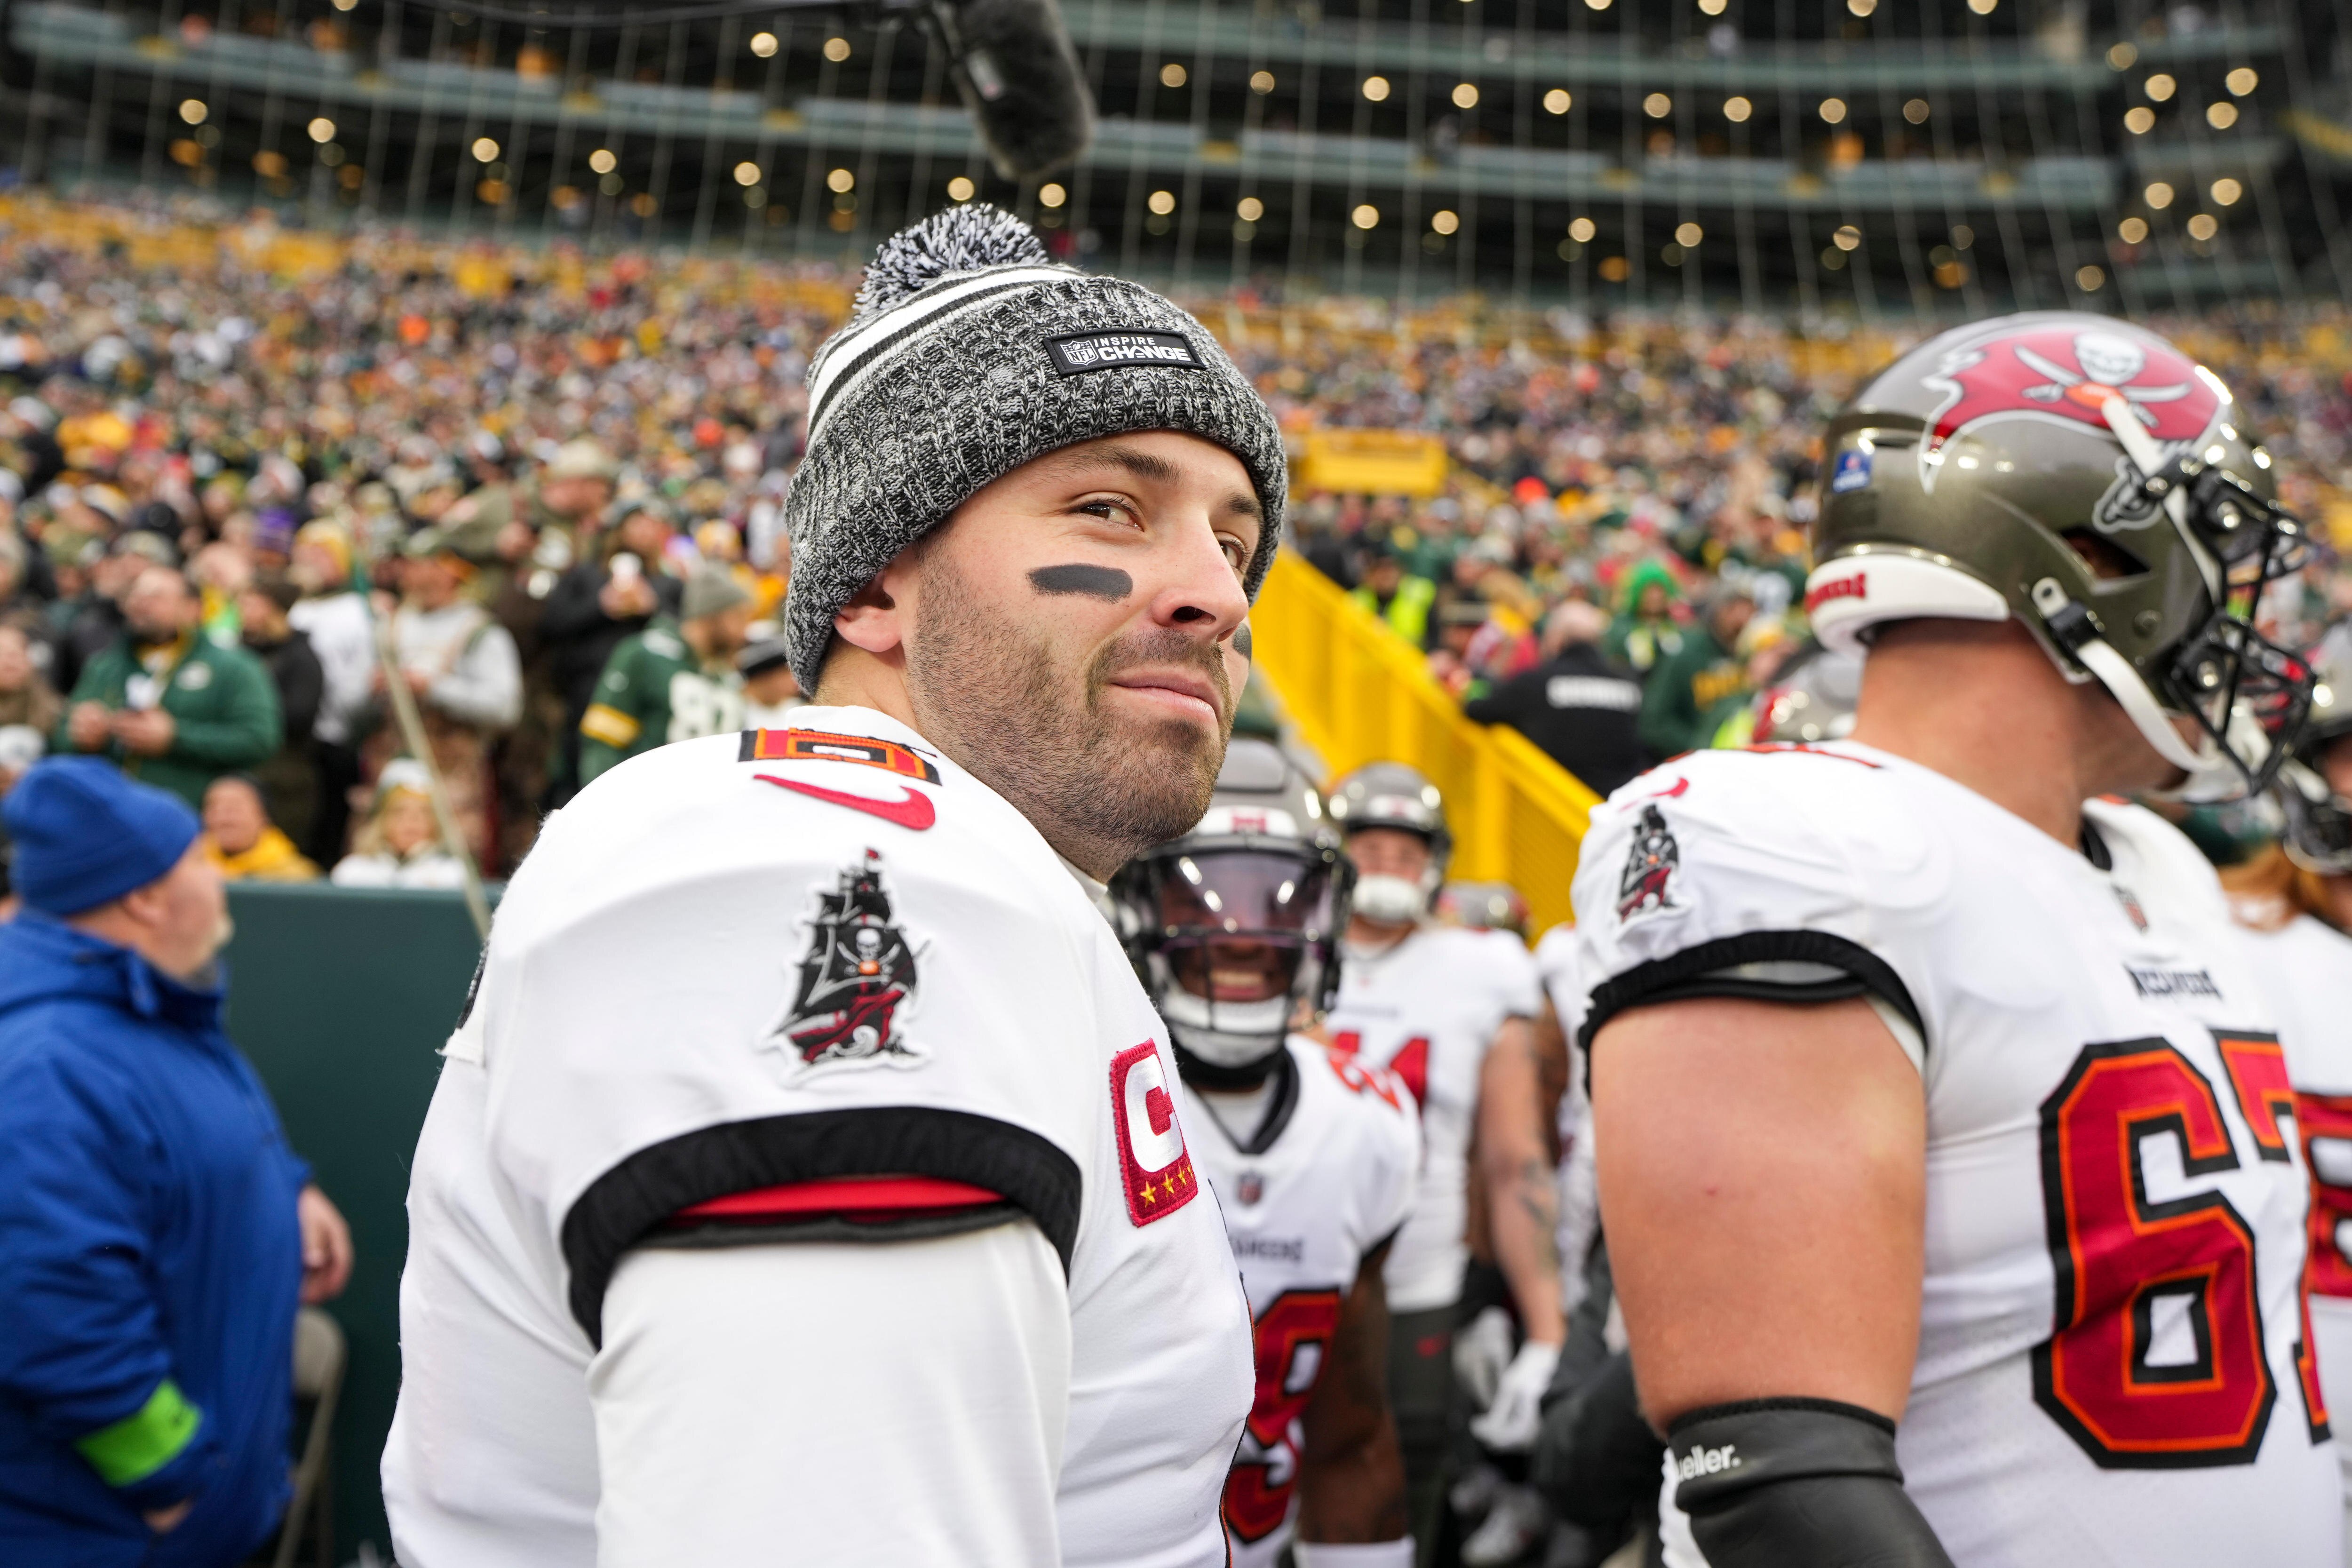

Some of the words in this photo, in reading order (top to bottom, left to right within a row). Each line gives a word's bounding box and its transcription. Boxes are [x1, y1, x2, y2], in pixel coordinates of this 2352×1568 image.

[1093, 337, 1155, 348] INSPIRE
[1068, 349, 1095, 362] NFL
[1097, 345, 1191, 361] CHANGE
[1124, 1053, 1184, 1173] C
